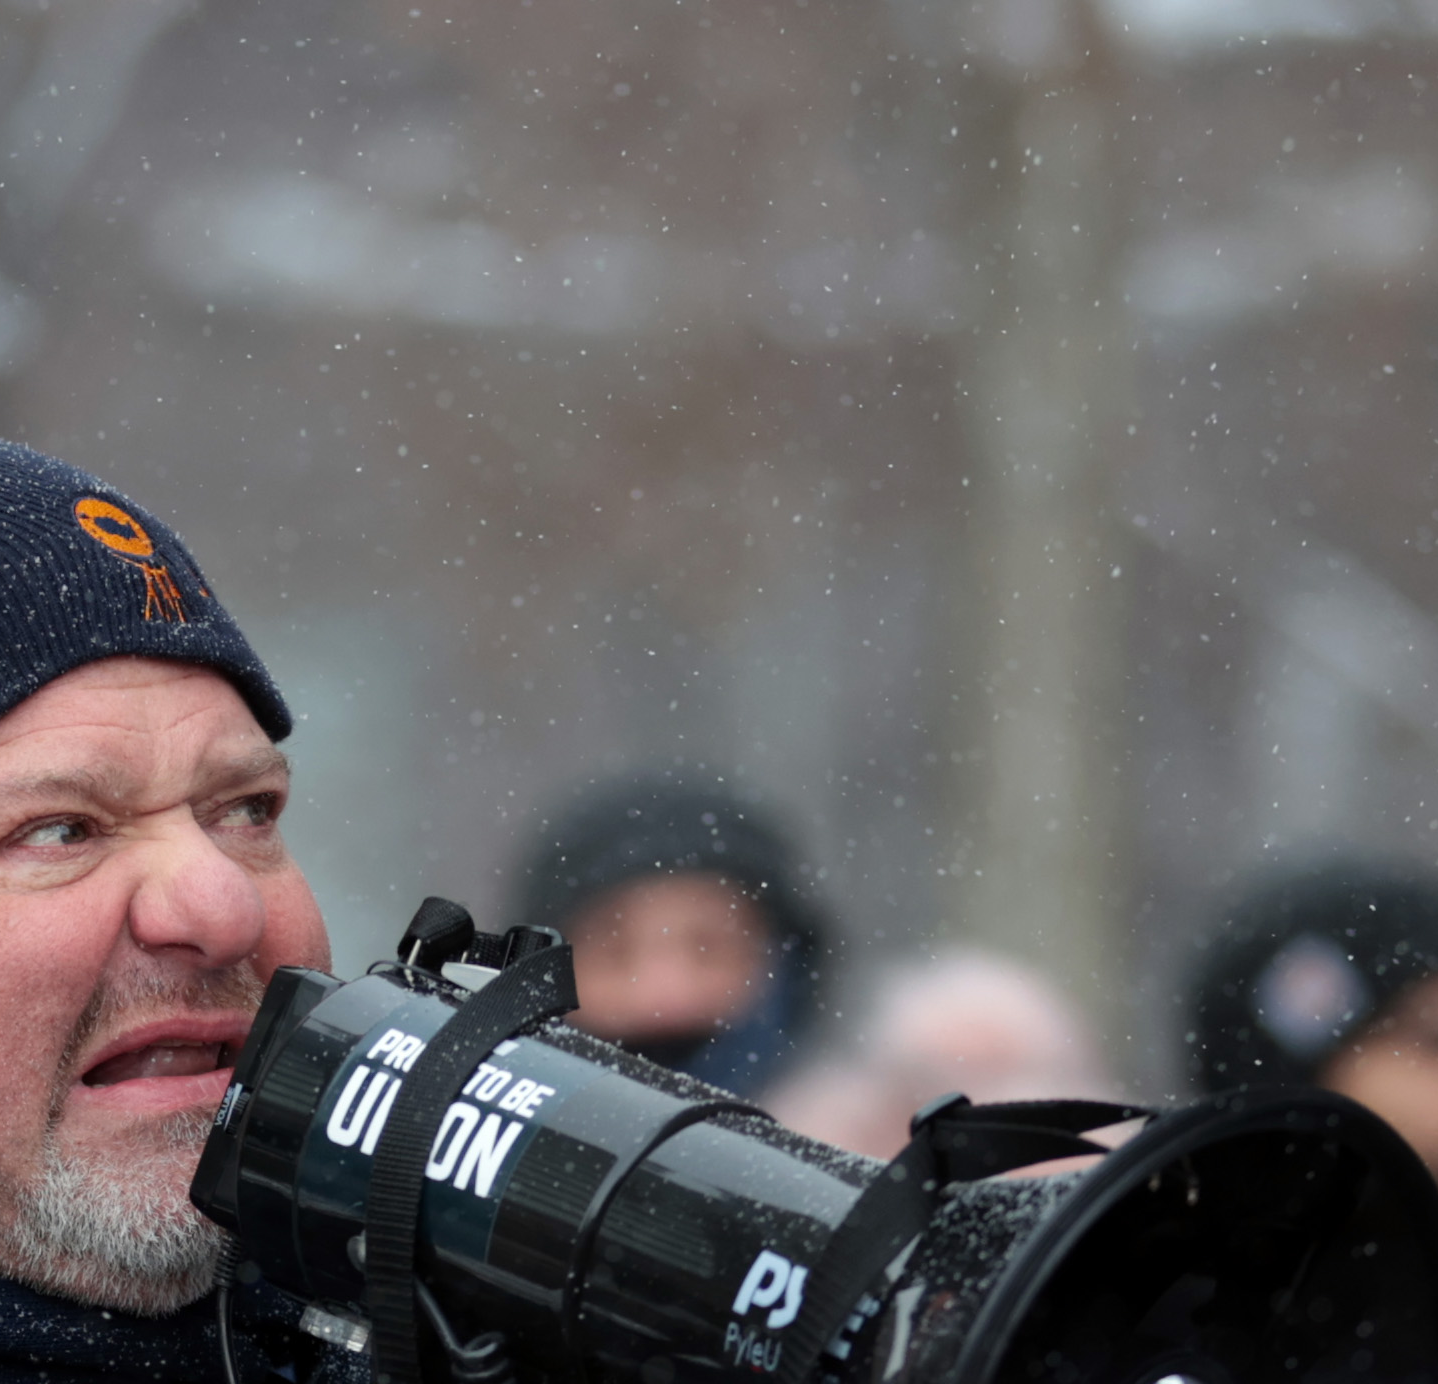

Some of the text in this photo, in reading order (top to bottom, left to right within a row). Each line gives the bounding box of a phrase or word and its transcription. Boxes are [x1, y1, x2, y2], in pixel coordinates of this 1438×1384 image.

[326, 1064, 524, 1199] UON
[462, 1062, 556, 1118] TO BE
